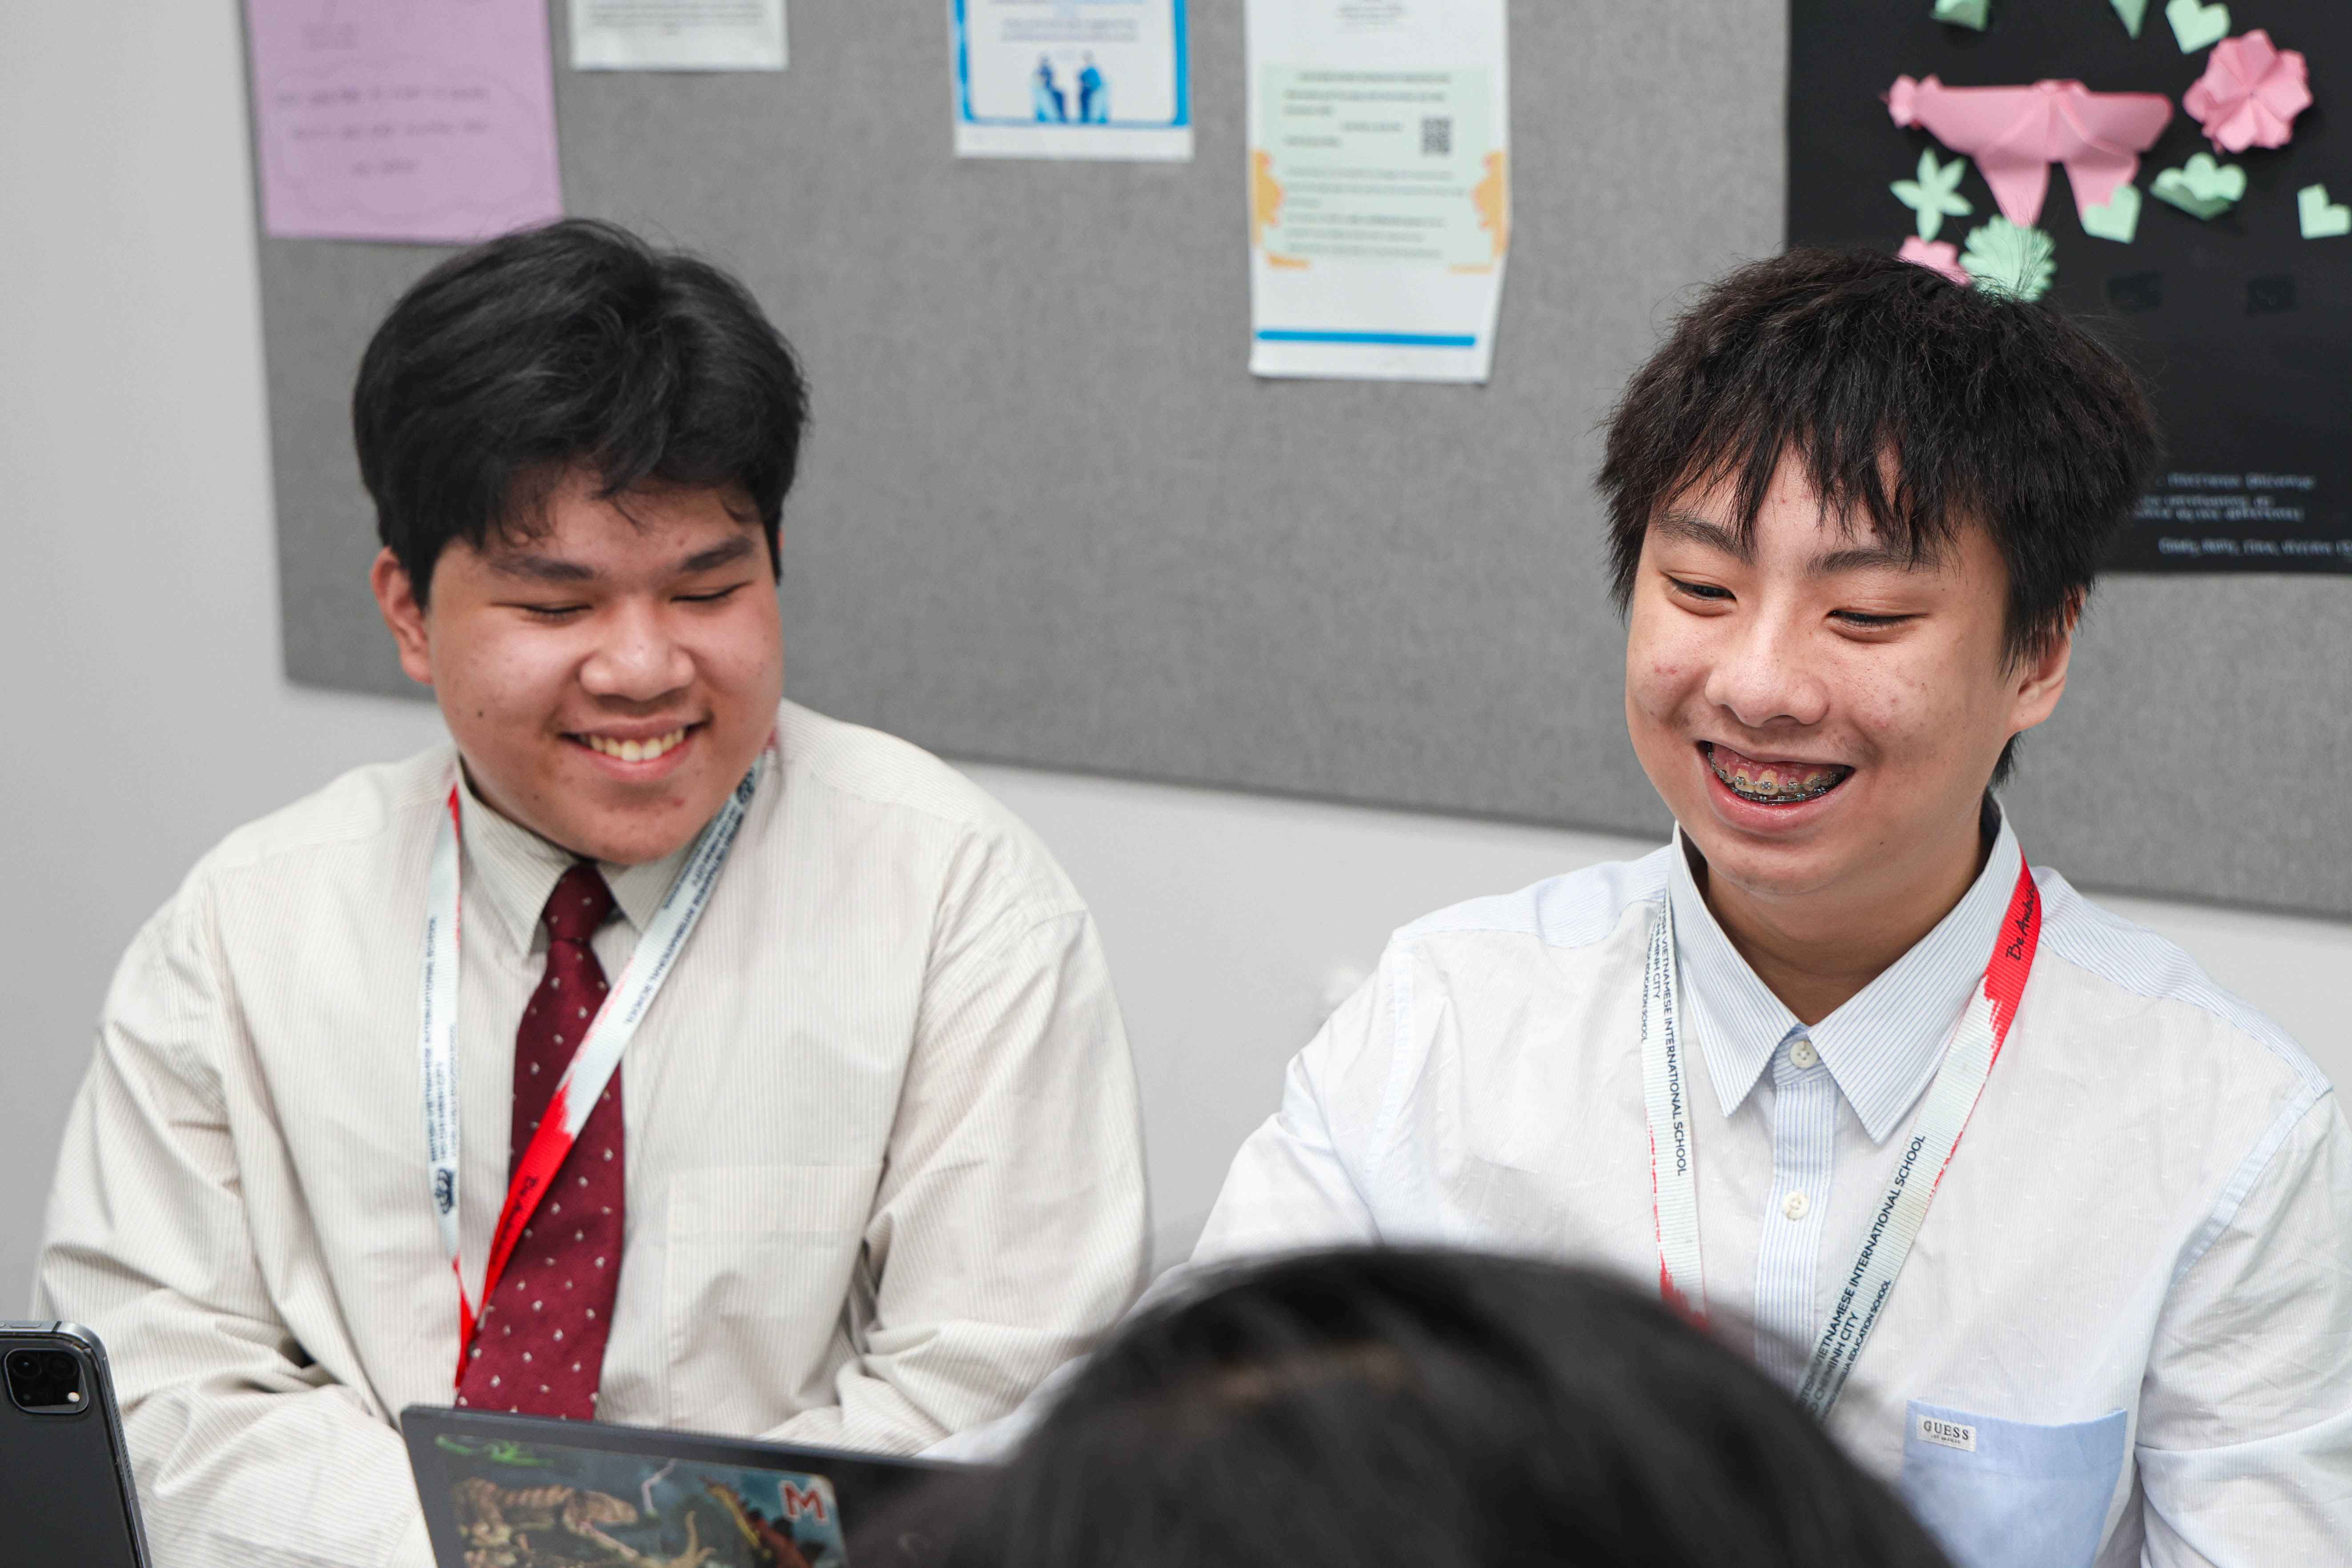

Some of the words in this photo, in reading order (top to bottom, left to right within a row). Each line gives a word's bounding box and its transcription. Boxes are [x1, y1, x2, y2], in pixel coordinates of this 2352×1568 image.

[1662, 935, 1673, 1016] VIETNAMESE
[2006, 936, 2024, 961] Be
[1652, 973, 1660, 999] CITY
[1664, 1017, 1682, 1120] INTERNATIONAL
[1673, 1121, 1687, 1176] SCHOOL
[1813, 1287, 1854, 1367] VIETNAMESE
[1849, 1189, 1901, 1287] INTERNATIONAL
[1895, 1136, 1926, 1187] SCHOOL
[1824, 1342, 1845, 1377] MINH
[1840, 1311, 1858, 1340] CITY
[1848, 1313, 1874, 1361] EDUCATION
[1870, 1279, 1891, 1313] SCHOOL
[1923, 1420, 1969, 1440] GUESS
